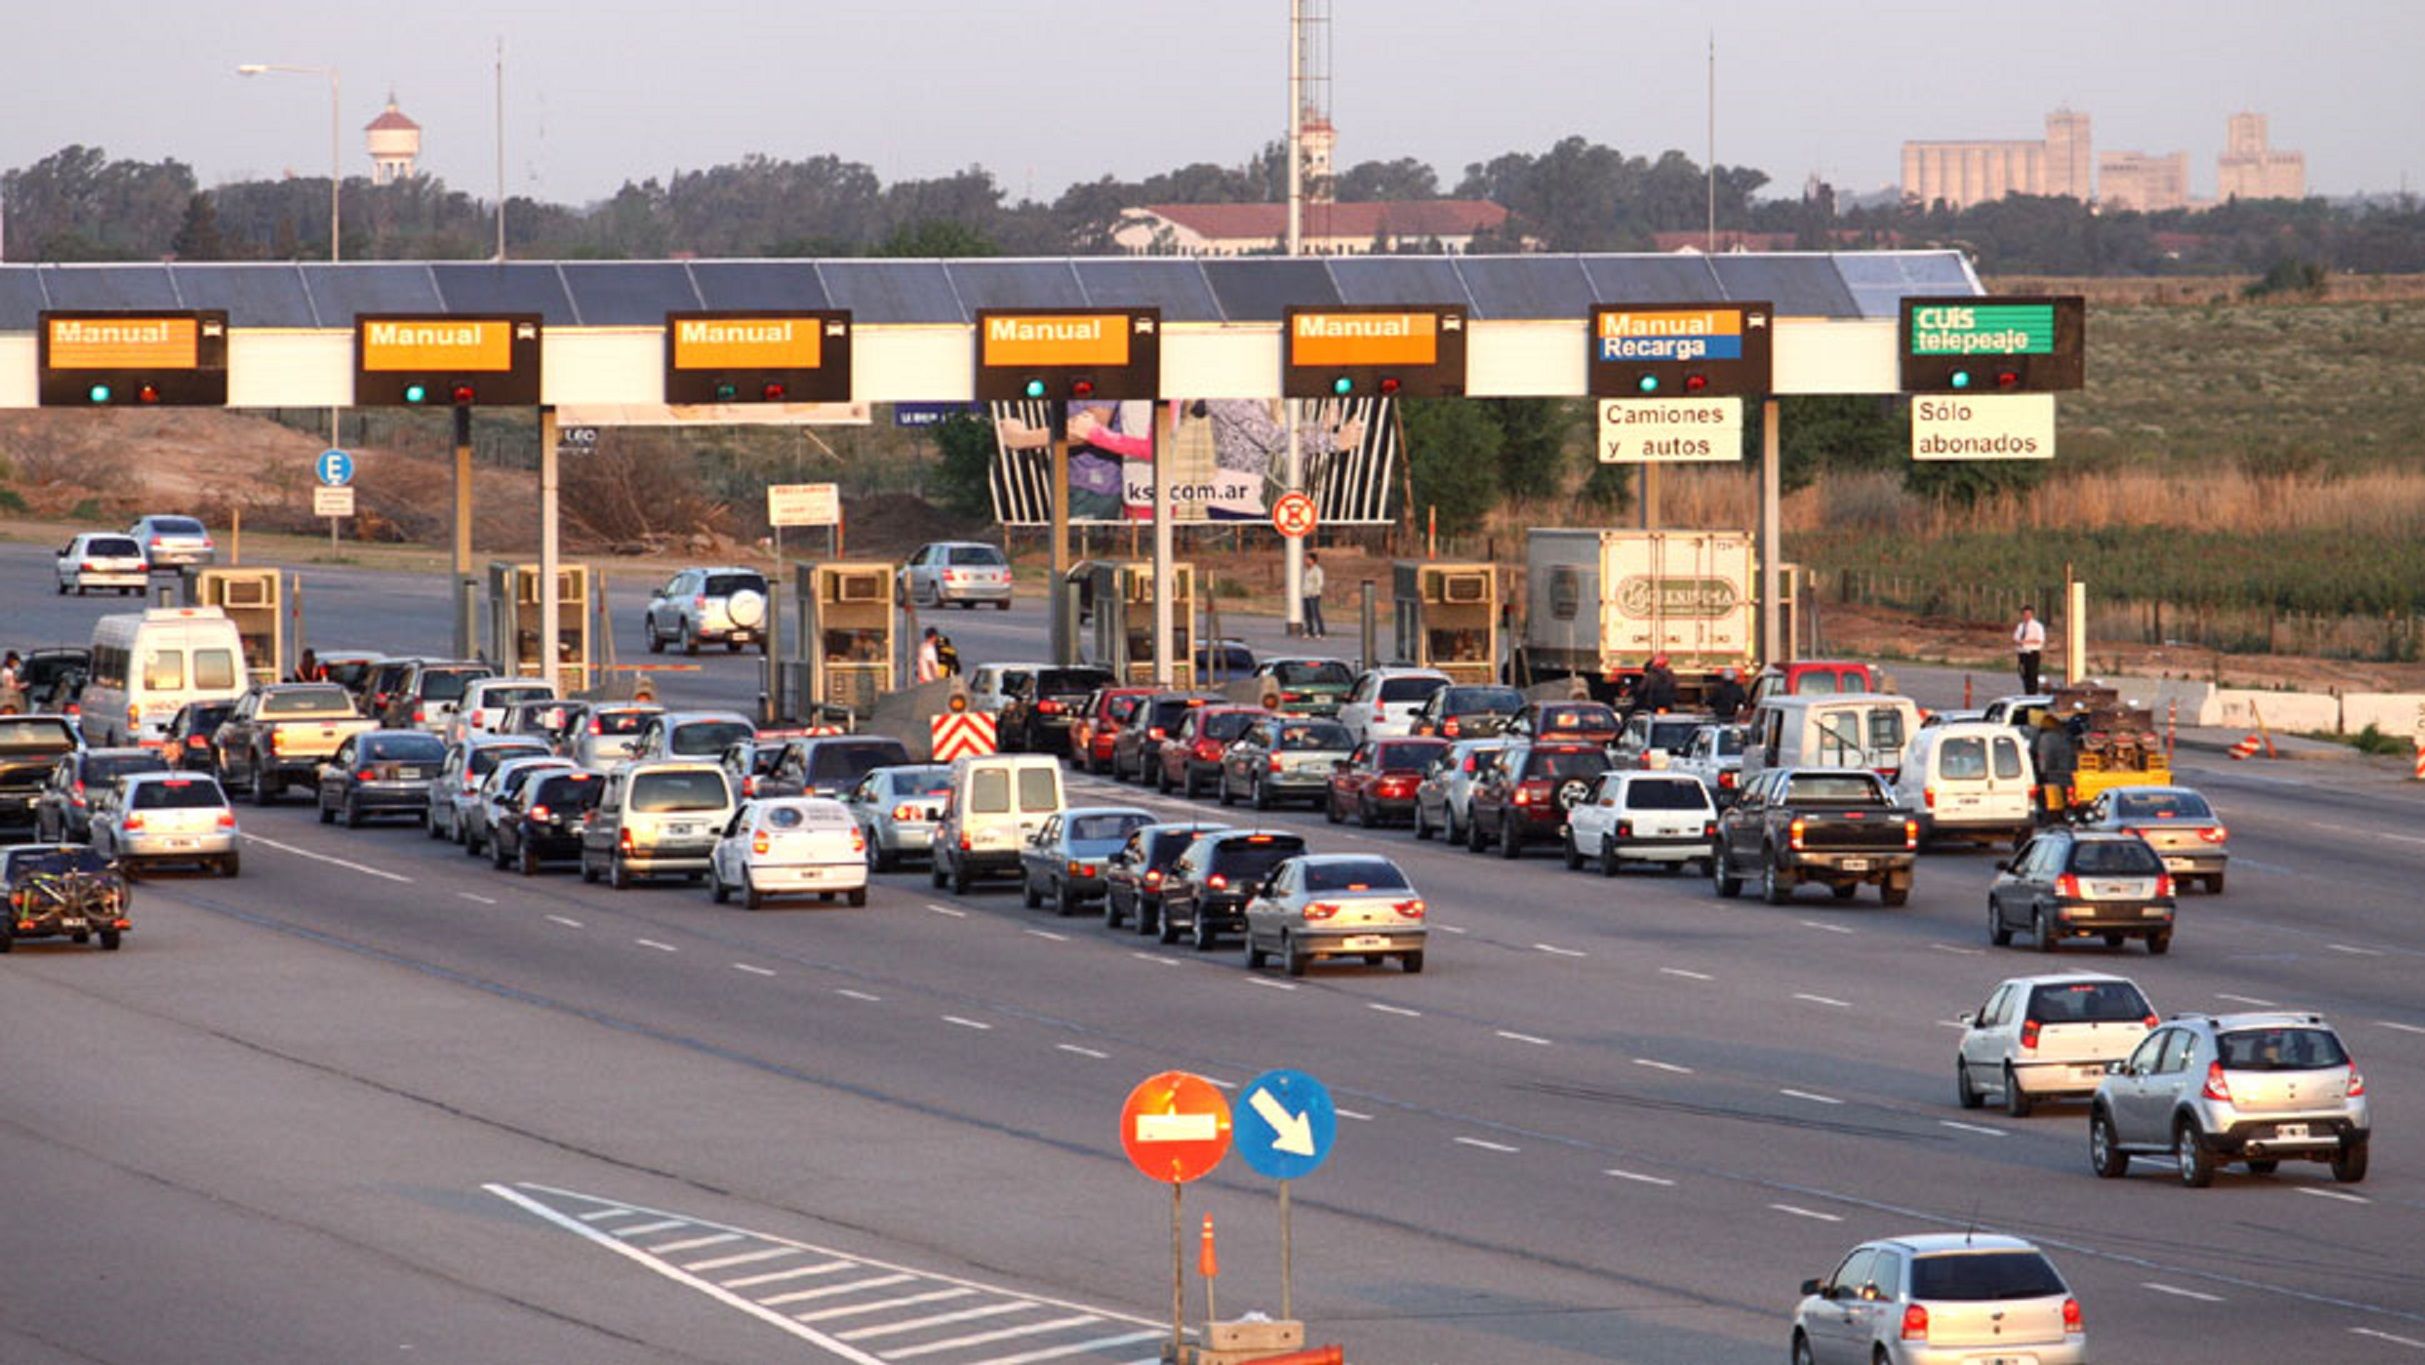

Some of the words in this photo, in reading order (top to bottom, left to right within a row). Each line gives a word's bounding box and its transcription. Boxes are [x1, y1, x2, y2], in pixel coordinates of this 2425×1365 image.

[54, 320, 170, 343] Manual
[370, 323, 481, 345] Manual
[681, 321, 792, 343] Manual
[991, 318, 1101, 340] Manual
[1299, 315, 1410, 336] Manual
[1604, 314, 1714, 335] Manual
[1604, 337, 1706, 360] Recarga
[1917, 328, 2029, 354] telepeaje
[1606, 404, 1724, 424] Camiones
[1919, 401, 1972, 421] Sólo
[1608, 441, 1621, 458] y
[1642, 436, 1711, 456] autos
[1919, 433, 2038, 454] abonados
[327, 455, 343, 480] E
